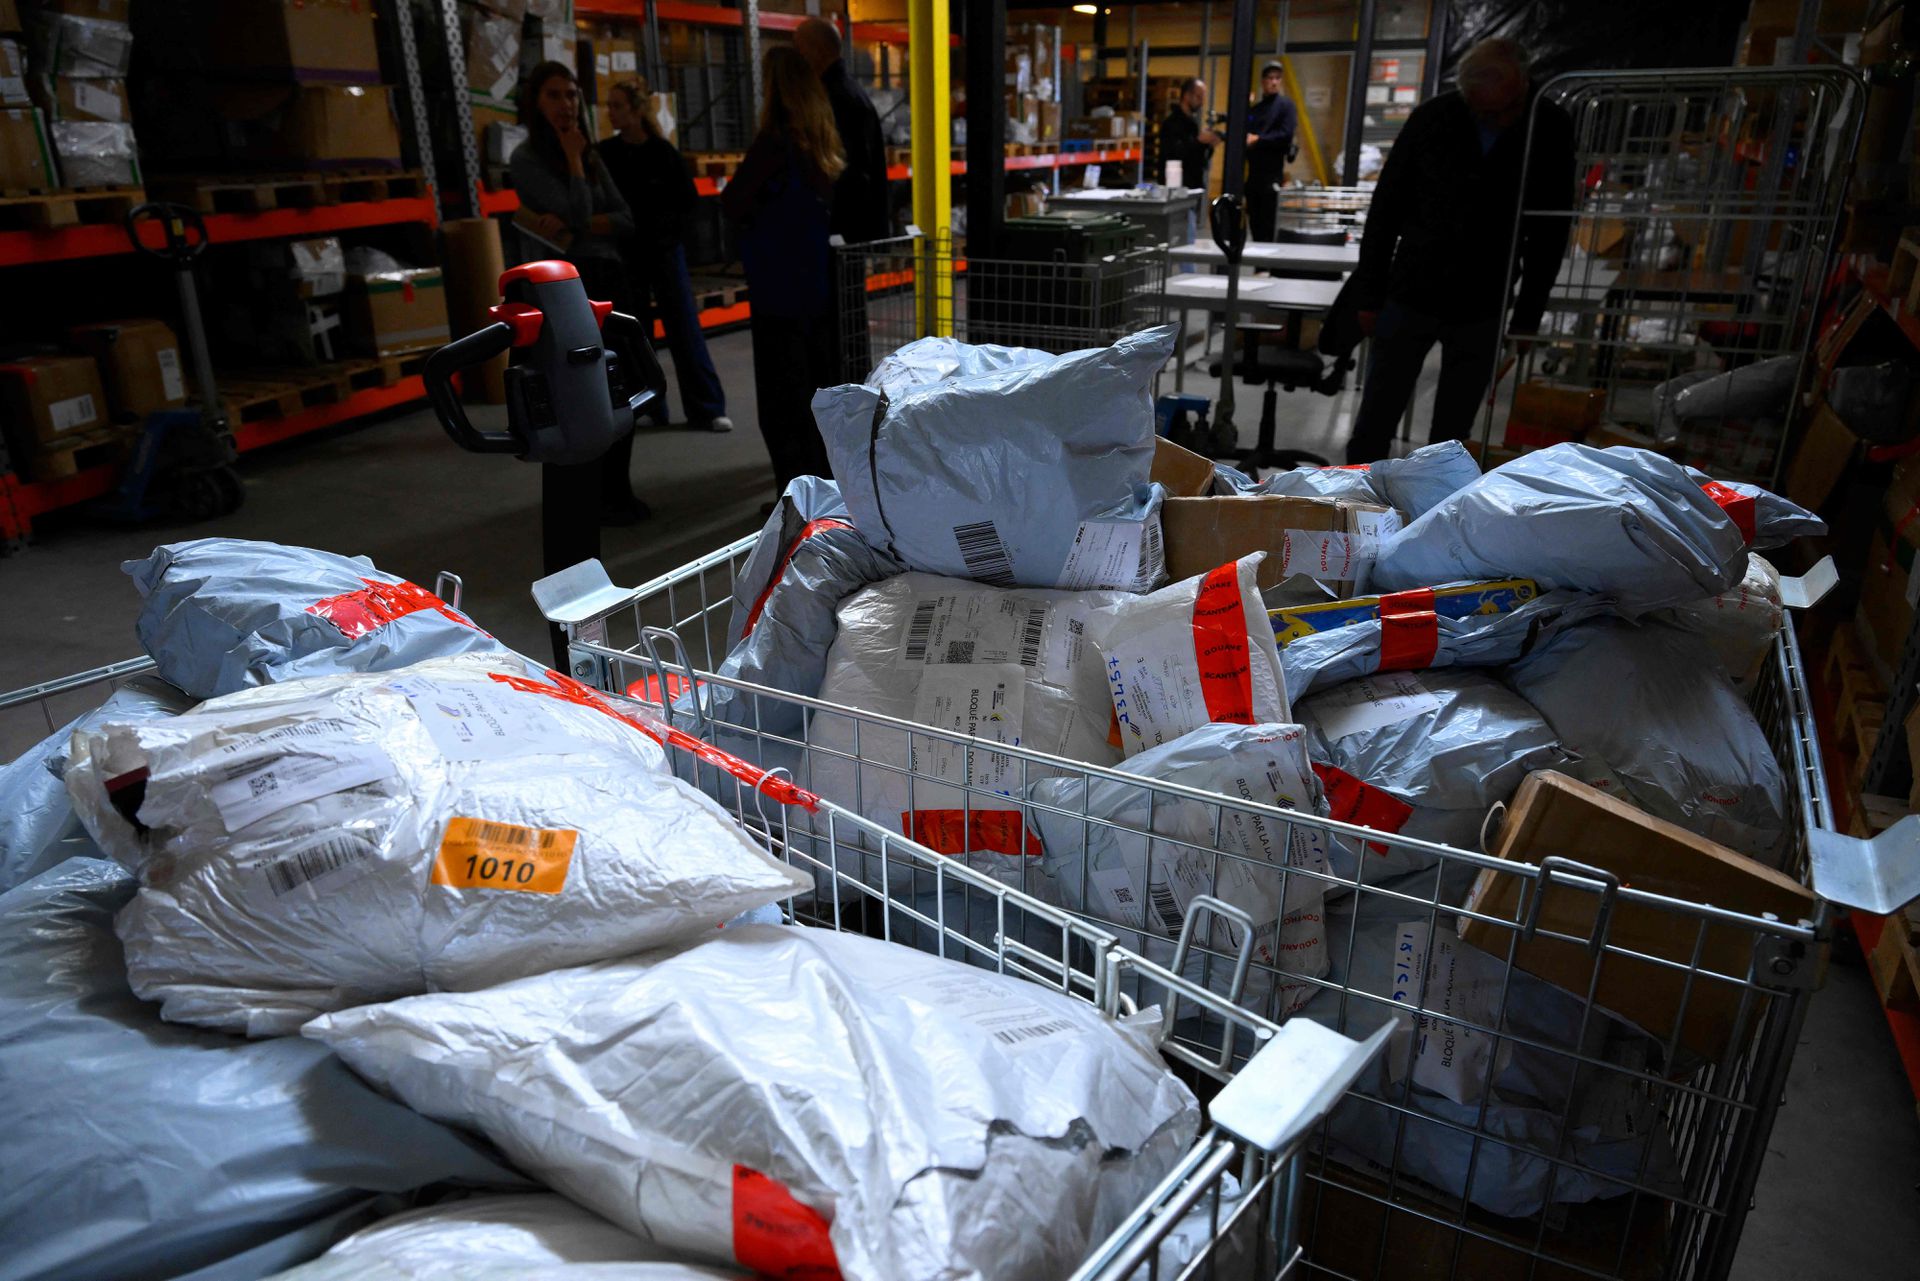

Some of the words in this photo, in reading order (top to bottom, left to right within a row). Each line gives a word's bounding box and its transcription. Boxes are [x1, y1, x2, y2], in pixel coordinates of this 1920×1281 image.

[1075, 525, 1086, 546] DHL
[1320, 539, 1330, 572] DOUANE
[1341, 536, 1352, 578] CONTROLE
[1201, 581, 1232, 596] OUANE
[1204, 644, 1242, 656] DOUANE
[968, 689, 979, 722] BLOQUÉ
[1252, 815, 1265, 833] PAR
[1260, 833, 1270, 847] LA
[466, 854, 535, 883] 1010
[1441, 1028, 1456, 1068] BLOQUÉ
